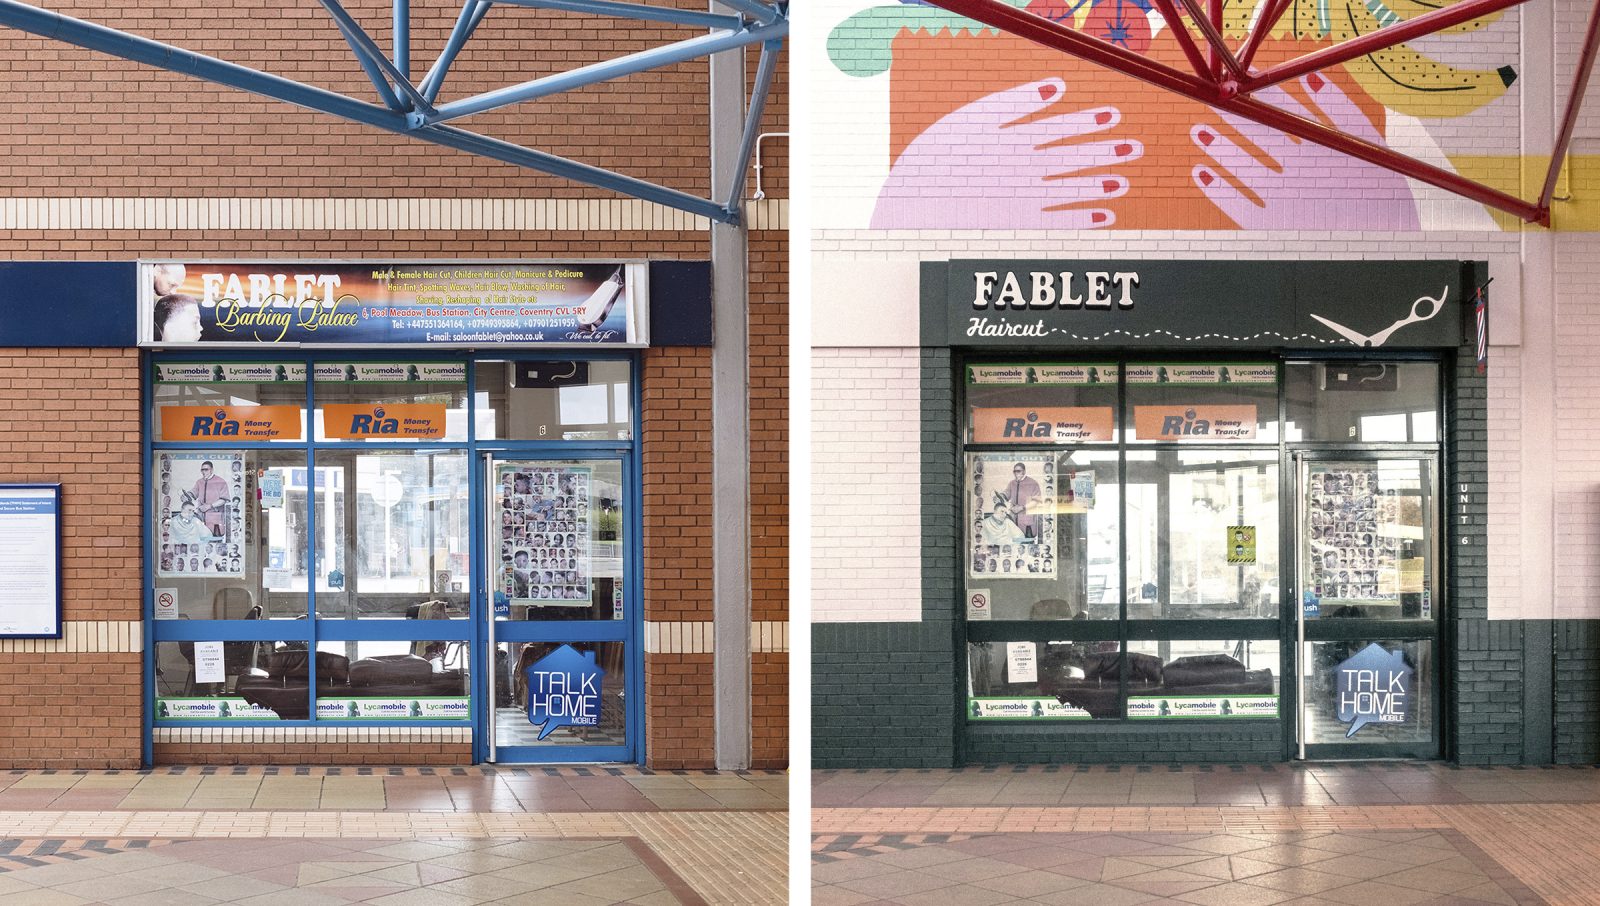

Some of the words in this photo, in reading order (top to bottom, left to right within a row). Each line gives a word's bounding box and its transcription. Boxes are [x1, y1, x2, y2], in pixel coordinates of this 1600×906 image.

[371, 271, 389, 279] Male
[390, 271, 395, 279] &
[396, 271, 421, 279] Female
[423, 271, 438, 279] Hair
[439, 271, 453, 280] Cut,
[500, 270, 513, 279] Cut,
[515, 270, 546, 278] Manicure
[547, 270, 553, 278] &
[554, 270, 584, 278] Pedicure
[201, 273, 341, 309] FABLET
[387, 283, 402, 291] Hair
[403, 283, 418, 293] Tint,
[419, 283, 448, 293] Spotting
[450, 283, 473, 292] Waves,
[474, 283, 491, 291] Hair
[491, 283, 509, 292] Blow,
[510, 283, 540, 293] Washing
[541, 283, 549, 291] of
[550, 283, 566, 292] Hair,
[972, 271, 1140, 309] FABLET
[446, 296, 482, 306] Reshaping
[485, 296, 493, 304] of
[510, 296, 526, 305] Style
[215, 293, 292, 343] Barbing
[296, 294, 360, 331] Palace
[362, 307, 369, 320] 6,
[371, 307, 388, 318] Pool
[389, 307, 424, 318] Meadow,
[425, 307, 440, 317] Bus
[442, 307, 472, 317] Station,
[473, 308, 488, 318] City
[489, 308, 518, 317] Centre,
[519, 307, 554, 318] Coventry
[555, 307, 570, 316] CVL
[572, 307, 587, 315] 5RY
[391, 320, 405, 329] Tel:
[966, 317, 1049, 337] Haircut
[426, 332, 452, 341] E-mail:
[452, 331, 544, 343] saloonfablet@yahoo.co.uk
[167, 367, 210, 375] Lycamobile
[229, 367, 272, 375] Lycamobile
[361, 367, 404, 375] Lycamobile
[423, 367, 466, 375] Lycamobile
[980, 369, 1022, 377] Lycamobile
[1042, 369, 1084, 377] Lycamobile
[1173, 369, 1215, 377] Lycamobile
[1234, 369, 1277, 377] Lycamobile
[191, 410, 240, 437] Ria
[244, 420, 272, 428] Money
[350, 408, 399, 434] Ria
[403, 418, 431, 426] Money
[1003, 412, 1052, 438] Ria
[1056, 421, 1084, 430] Money
[1161, 408, 1210, 436] Ria
[1214, 419, 1242, 428] Money
[244, 429, 280, 438] Transfer
[403, 427, 439, 436] Transfer
[540, 425, 546, 435] 6
[1056, 430, 1092, 438] Transfer
[1214, 428, 1250, 437] Transfer
[1460, 484, 1469, 524] UNIT
[1461, 536, 1469, 545] 6
[494, 604, 509, 612] ush
[1304, 604, 1318, 612] ush
[534, 672, 598, 695] TALK
[1342, 670, 1405, 693] TALK
[173, 704, 216, 712] Lycamobile
[363, 703, 407, 711] Lycamobile
[426, 703, 469, 711] Lycamobile
[533, 694, 598, 717] HOME
[986, 703, 1028, 712] Lycamobile
[1175, 702, 1217, 710] Lycamobile
[1236, 701, 1278, 709] Lycamobile
[1341, 692, 1405, 715] HOME
[571, 717, 597, 725] MOBILE
[1378, 714, 1405, 722] MOBILE
